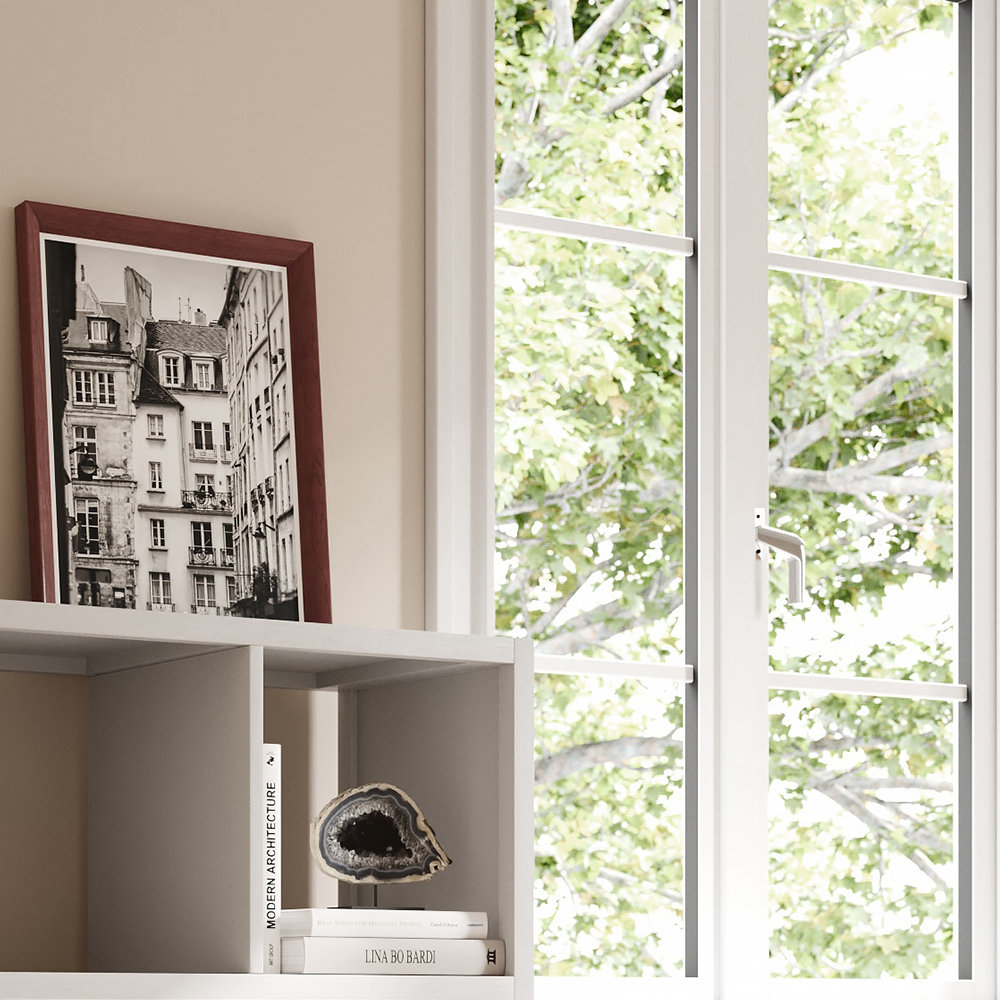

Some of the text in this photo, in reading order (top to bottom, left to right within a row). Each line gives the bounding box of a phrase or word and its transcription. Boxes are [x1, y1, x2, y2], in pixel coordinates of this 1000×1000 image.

[267, 782, 276, 929] MODERN ARCHITECTURE
[365, 949, 436, 964] LINA BO BARDI
